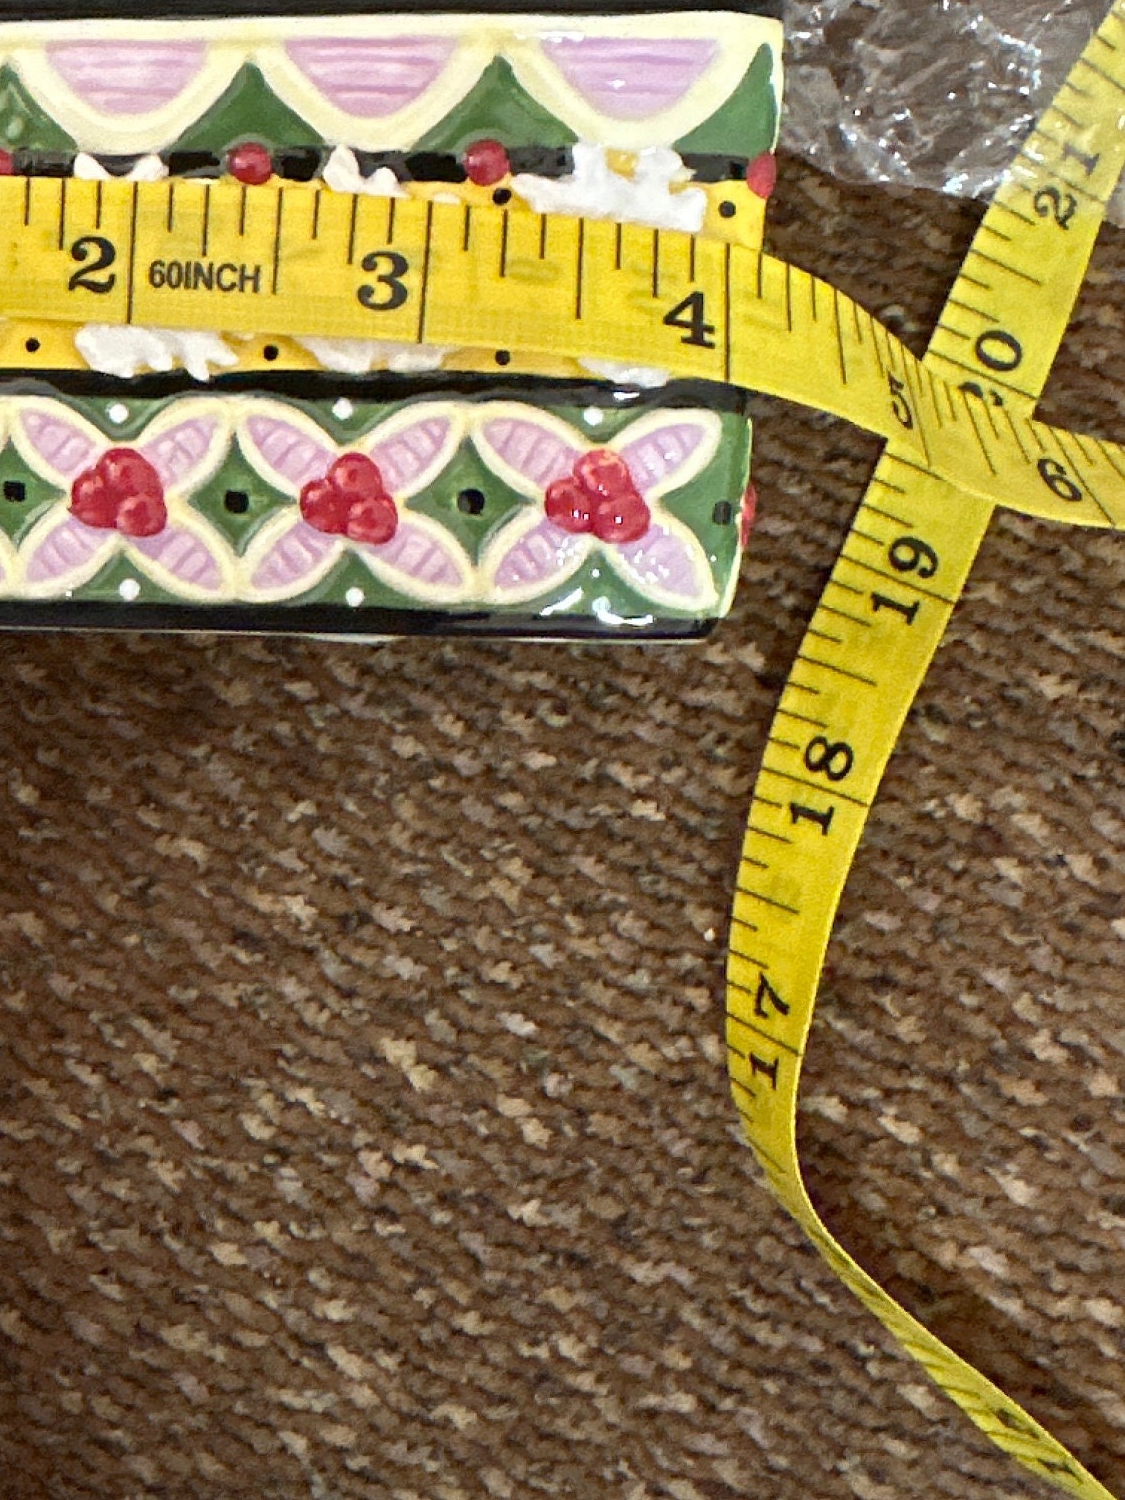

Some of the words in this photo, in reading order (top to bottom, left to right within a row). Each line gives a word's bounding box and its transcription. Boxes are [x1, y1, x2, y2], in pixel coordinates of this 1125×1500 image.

[68, 236, 116, 293] 2
[149, 260, 261, 293] 60INCH
[357, 251, 409, 310] 3
[663, 291, 716, 350] 4
[888, 370, 913, 430] 5
[1037, 458, 1083, 502] 6
[871, 536, 938, 626] 19
[789, 736, 854, 836] 18
[749, 974, 791, 1090] 17
